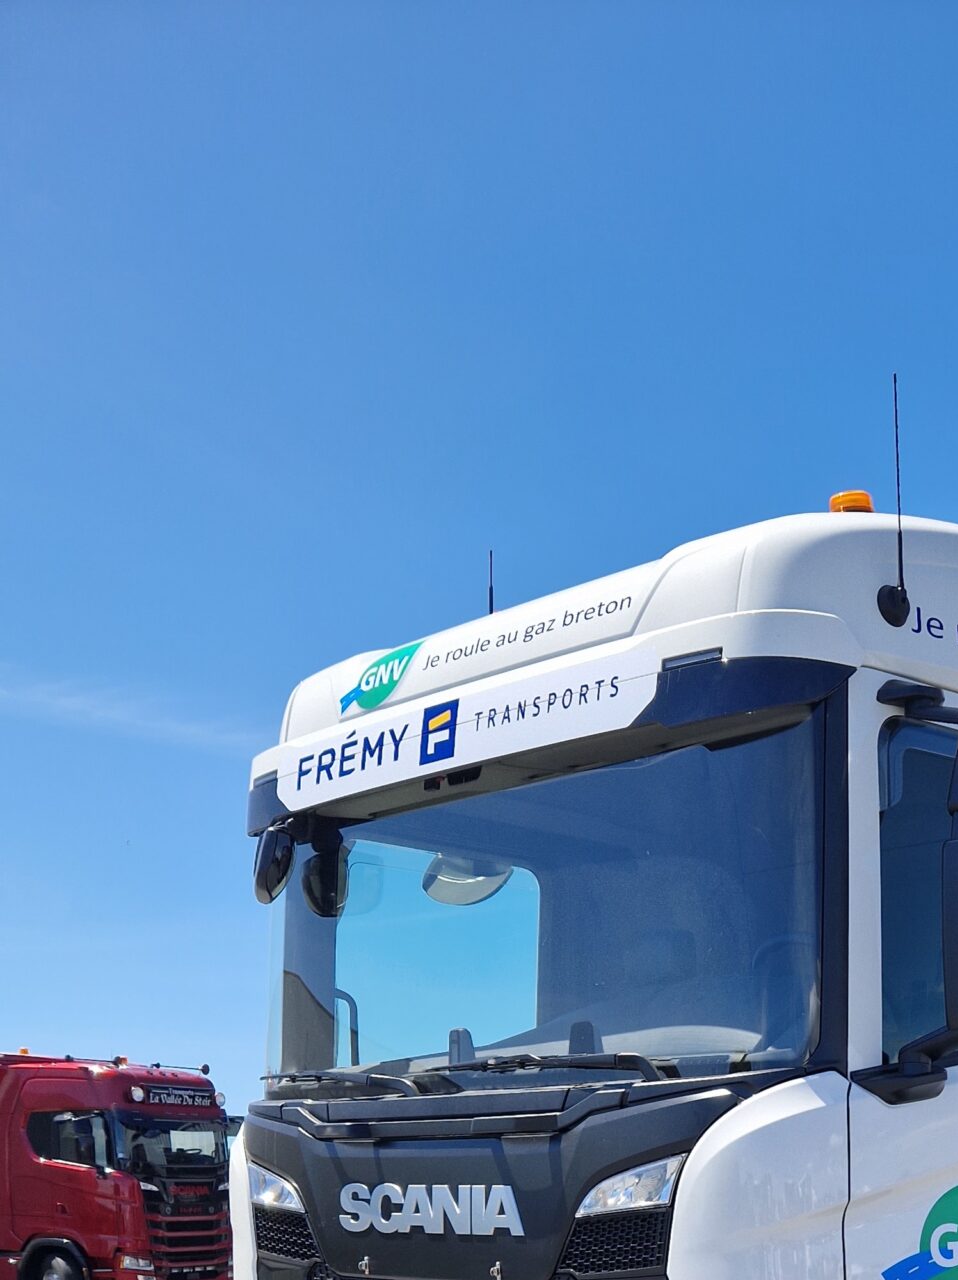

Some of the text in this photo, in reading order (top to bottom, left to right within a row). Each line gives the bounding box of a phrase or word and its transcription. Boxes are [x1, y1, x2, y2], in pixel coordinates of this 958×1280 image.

[422, 595, 633, 671] Je roule au gaz breton
[911, 606, 944, 639] Je
[359, 655, 410, 692] GNV
[296, 723, 410, 792] FRÉMY
[474, 676, 621, 732] TRANSPORTS
[149, 1092, 159, 1104] La
[182, 1095, 193, 1106] Du
[338, 1182, 526, 1237] SCANIA
